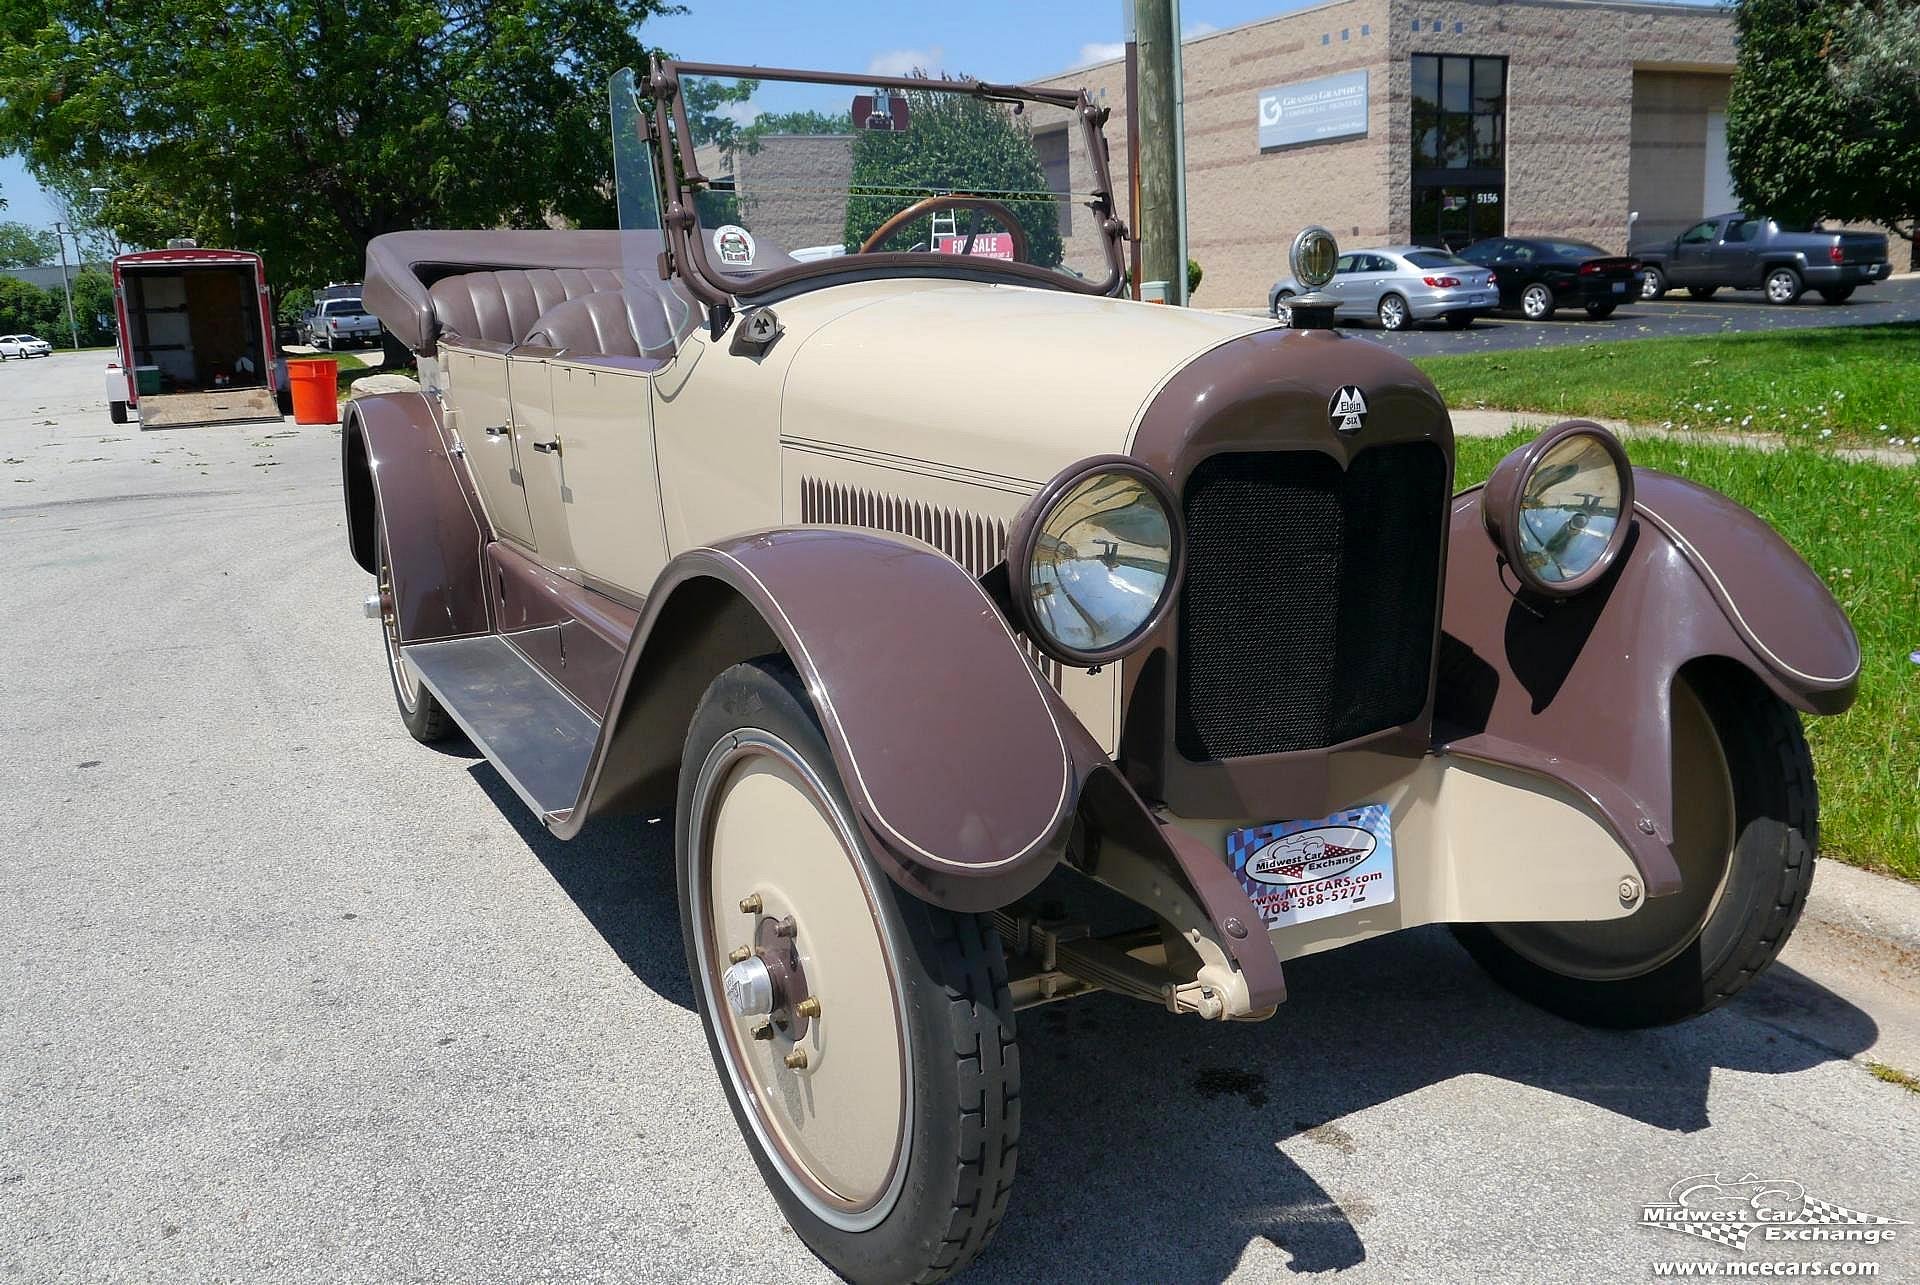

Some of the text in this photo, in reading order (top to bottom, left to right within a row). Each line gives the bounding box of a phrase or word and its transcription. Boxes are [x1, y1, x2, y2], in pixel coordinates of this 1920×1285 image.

[1476, 193, 1498, 204] 5156
[972, 237, 997, 252] SALE
[1340, 400, 1361, 413] Elgin
[1255, 851, 1322, 872] Midwest Car
[1308, 854, 1362, 871] Exchange
[1251, 872, 1383, 906] ww.MCECARS.com
[1262, 883, 1367, 917] 708-388-5277
